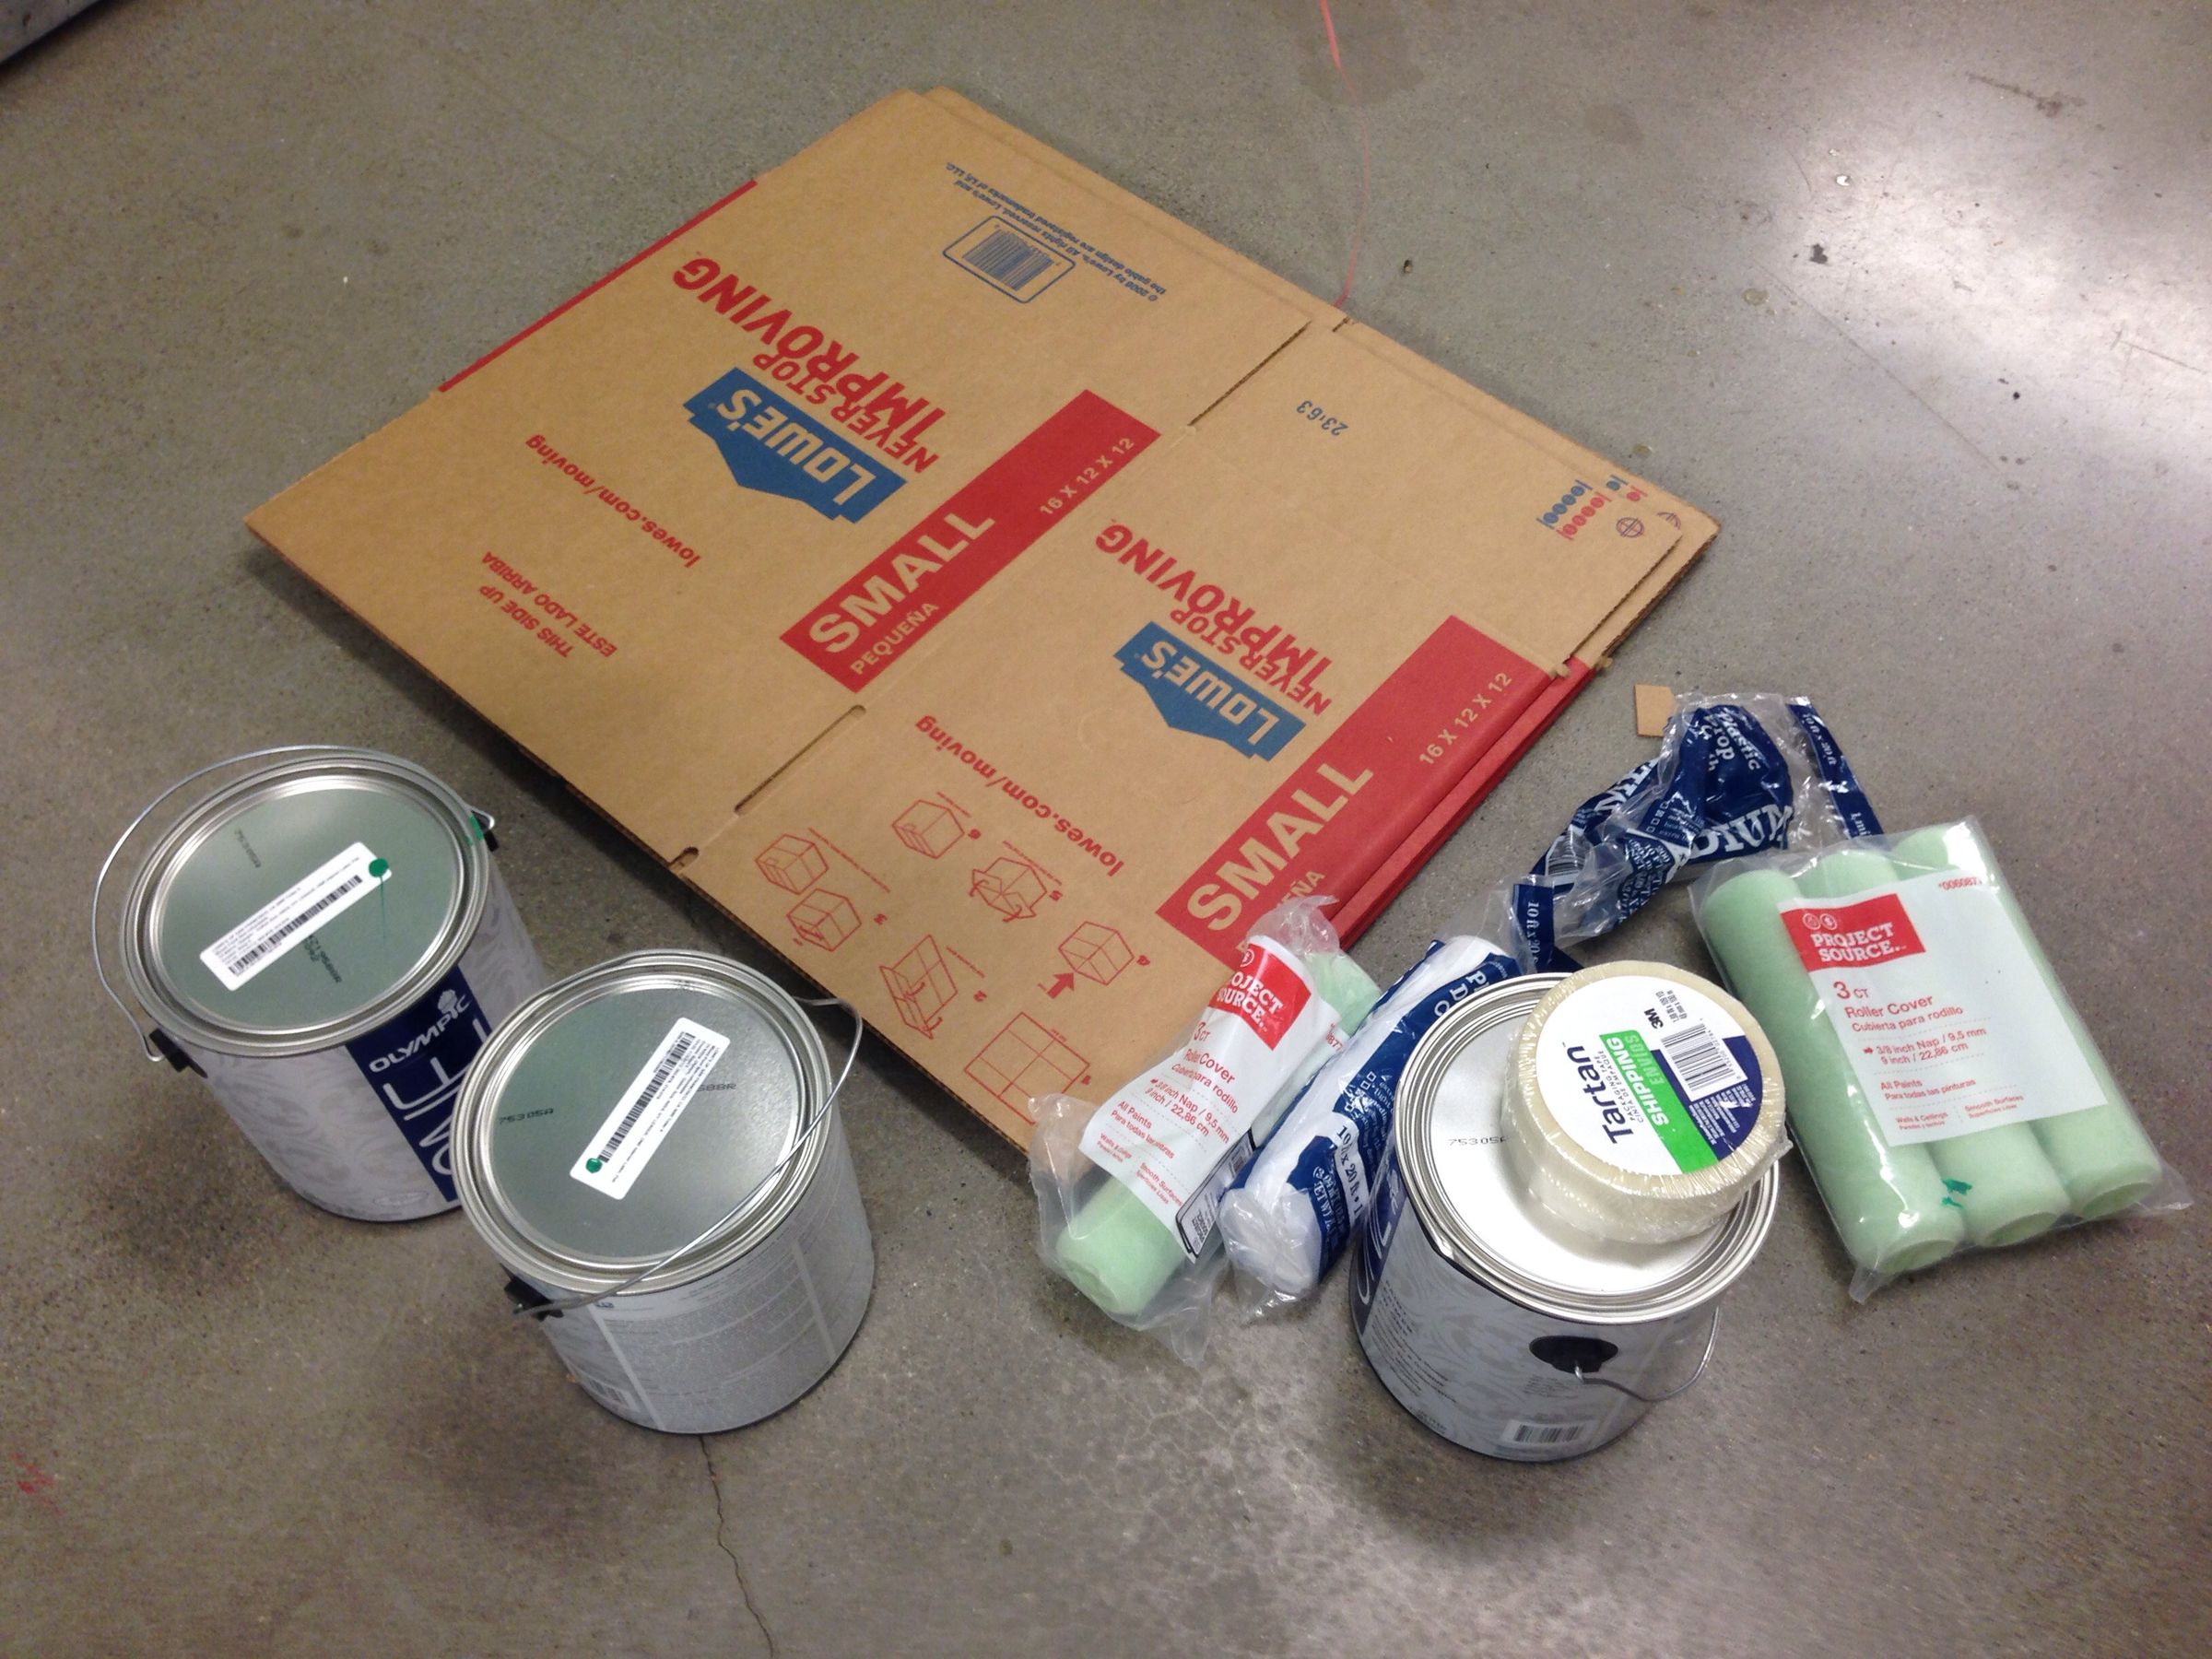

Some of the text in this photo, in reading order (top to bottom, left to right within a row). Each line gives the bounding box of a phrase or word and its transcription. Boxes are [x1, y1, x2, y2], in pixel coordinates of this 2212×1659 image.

[988, 188, 1036, 219] trademarks
[1036, 217, 1080, 243] registered
[1095, 251, 1124, 270] design
[672, 257, 947, 444] IMPROVING
[752, 351, 940, 475] NEVER STOP
[715, 388, 877, 507] LOWE'S
[1040, 498, 1064, 514] 16
[1076, 467, 1100, 485] 12
[1112, 438, 1135, 454] 12
[525, 434, 702, 569] lowes.com/moving
[481, 551, 618, 658] ESTE LADO ARRIBA
[809, 512, 996, 653] SMALL
[1095, 523, 1333, 689] IMPROVING
[478, 584, 575, 658] THIS SIDE UP
[850, 601, 940, 675] PEQUEÑA
[1170, 606, 1333, 716] NEVER STOP
[1139, 640, 1281, 747] LOWE'S
[1419, 744, 1444, 764] 16
[1454, 708, 1478, 728] 12
[1488, 672, 1512, 692] 12
[1719, 708, 1762, 771] Plastic
[914, 714, 1124, 877] lowes.com/moving
[1187, 763, 1373, 931] SMALL
[1526, 901, 1540, 917] 10
[1810, 921, 1894, 947] PROJECT
[1231, 971, 1284, 1015] OJECT
[1832, 980, 1869, 1000] 3 CT
[1844, 995, 1933, 1018] Roller Cover
[369, 994, 472, 1074] OLYMPIC
[1643, 1007, 1664, 1030] 3M
[1852, 1006, 1964, 1032] Cubierta para rodillo
[1893, 1042, 1915, 1054] inch
[1917, 1038, 1940, 1050] Nap
[1966, 1027, 1987, 1038] mm
[1199, 1053, 1235, 1084] Cover
[1624, 1034, 1665, 1086] ENVIOS
[1881, 1056, 1888, 1065] 9
[1888, 1053, 1911, 1065] inch
[1950, 1042, 1970, 1053] cm
[1213, 1084, 1239, 1113] rodillo
[1567, 1045, 1634, 1145] Tartan
[1594, 1055, 1636, 1122] PACKAGING TAPE
[1597, 1051, 1644, 1124] CINTA DE EMPAQUE
[1606, 1037, 1669, 1126] SHIPPING
[1881, 1079, 1924, 1090] All Paints
[1885, 1078, 1977, 1100] Para todas las pinturas
[1111, 1110, 1128, 1125] Para
[1126, 1121, 1147, 1139] todas
[1118, 1100, 1153, 1129] All Paints
[1179, 1093, 1199, 1113] Nap
[1217, 1126, 1230, 1144] mm
[1196, 1122, 1210, 1136] cm
[1336, 1124, 1352, 1145] 10
[1340, 1153, 1350, 1166] x
[1345, 1164, 1358, 1183] 20
[1349, 1181, 1363, 1197] ft
